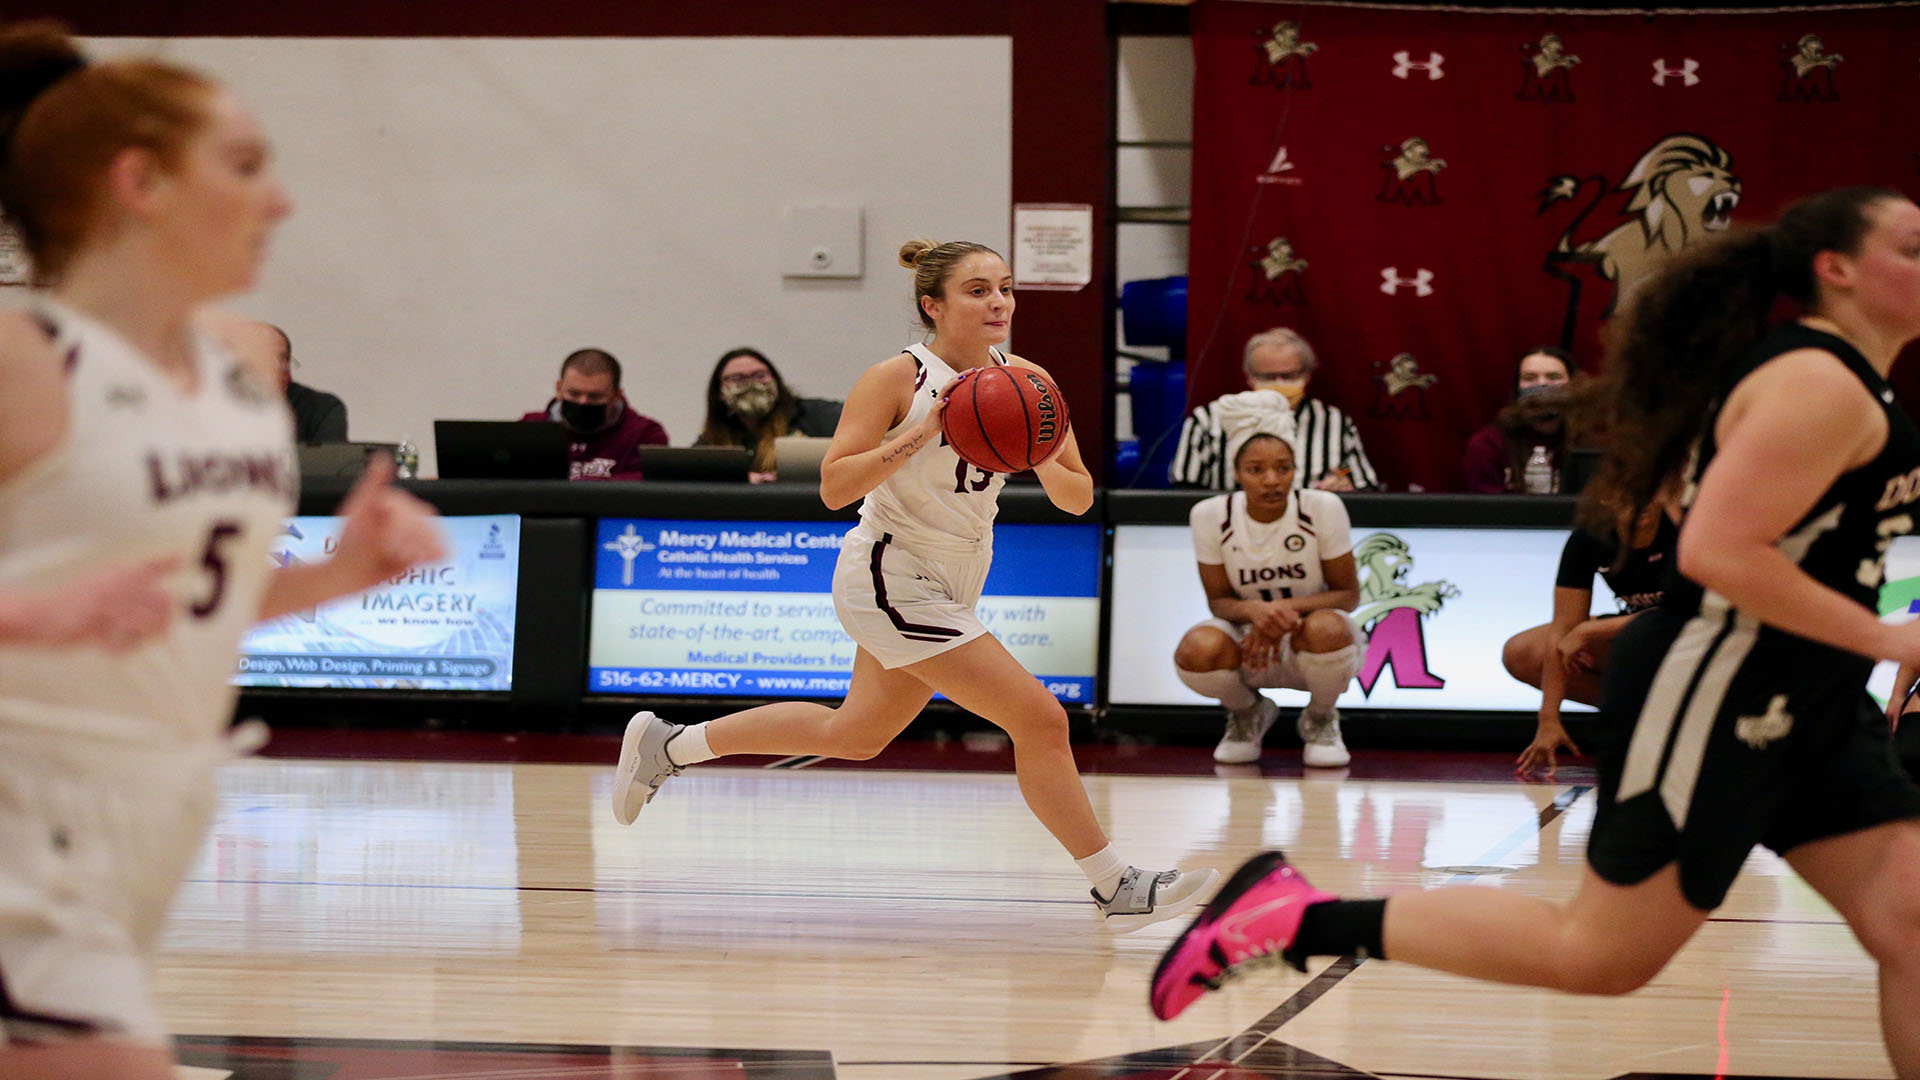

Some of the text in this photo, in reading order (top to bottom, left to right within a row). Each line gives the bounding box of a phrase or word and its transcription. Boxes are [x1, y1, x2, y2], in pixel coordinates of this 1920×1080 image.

[1025, 373, 1057, 444] Wilson
[659, 530, 845, 550] Mercy Medical Cente
[658, 550, 809, 565] Catholic Health Services
[186, 518, 241, 620] 5
[658, 567, 781, 580] At the heart of health
[1239, 562, 1307, 586] LIONS
[362, 592, 477, 612] IMAGERY
[640, 599, 747, 617] Committed
[753, 601, 773, 617] to
[1003, 604, 1047, 621] with
[403, 616, 440, 625] know
[629, 623, 785, 643] state-of-the-art,
[1007, 632, 1056, 647] care.
[286, 657, 318, 671] Web
[321, 658, 370, 674] Design,
[372, 660, 423, 675] Printing
[426, 661, 438, 674] &
[441, 660, 491, 676] Signage
[688, 651, 749, 665] Medical
[753, 652, 826, 666] Providers
[600, 670, 742, 689] 516-62-MERCY
